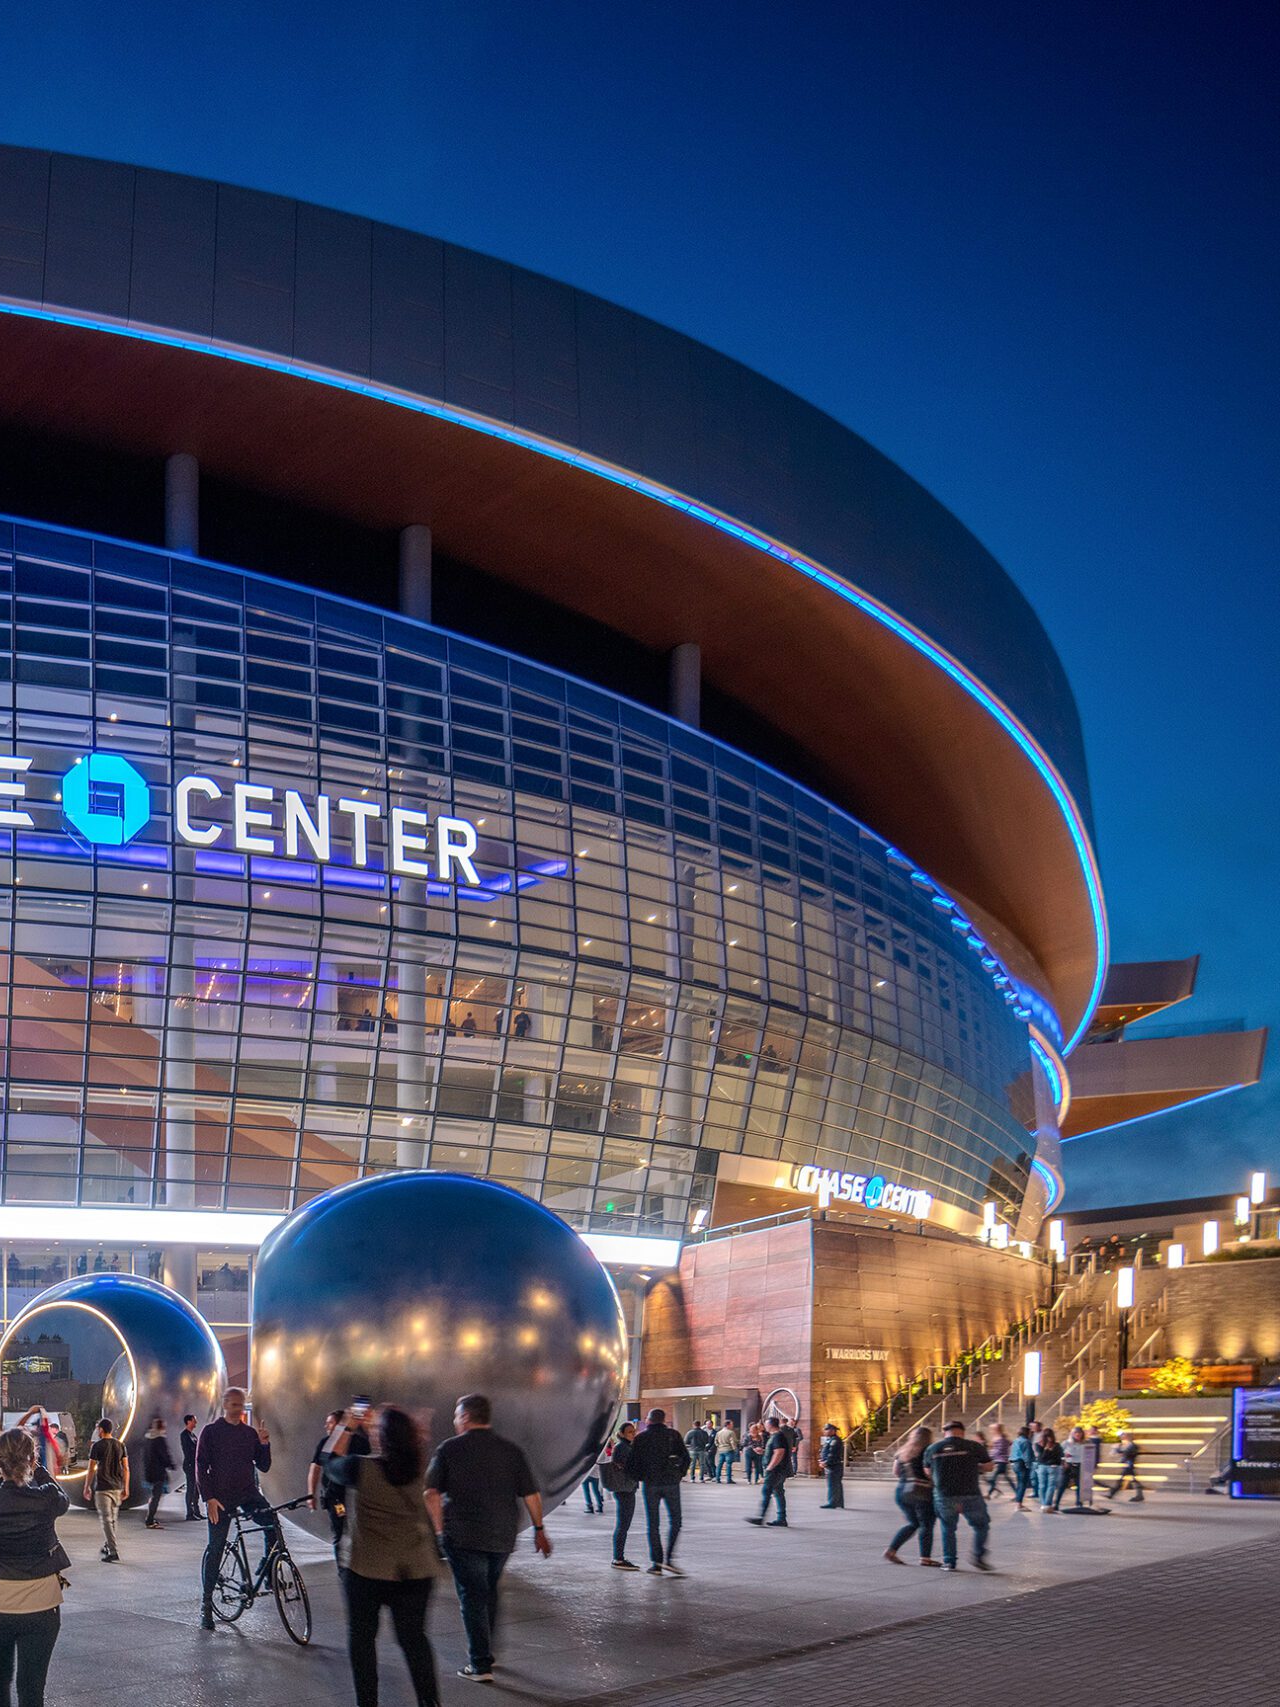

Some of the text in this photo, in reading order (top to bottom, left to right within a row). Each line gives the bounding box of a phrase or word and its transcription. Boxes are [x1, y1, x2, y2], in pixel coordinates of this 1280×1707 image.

[175, 775, 482, 886] CENTER
[797, 1165, 867, 1204] CHASE
[831, 1348, 872, 1360] WARRIORS
[872, 1350, 890, 1361] WAY
